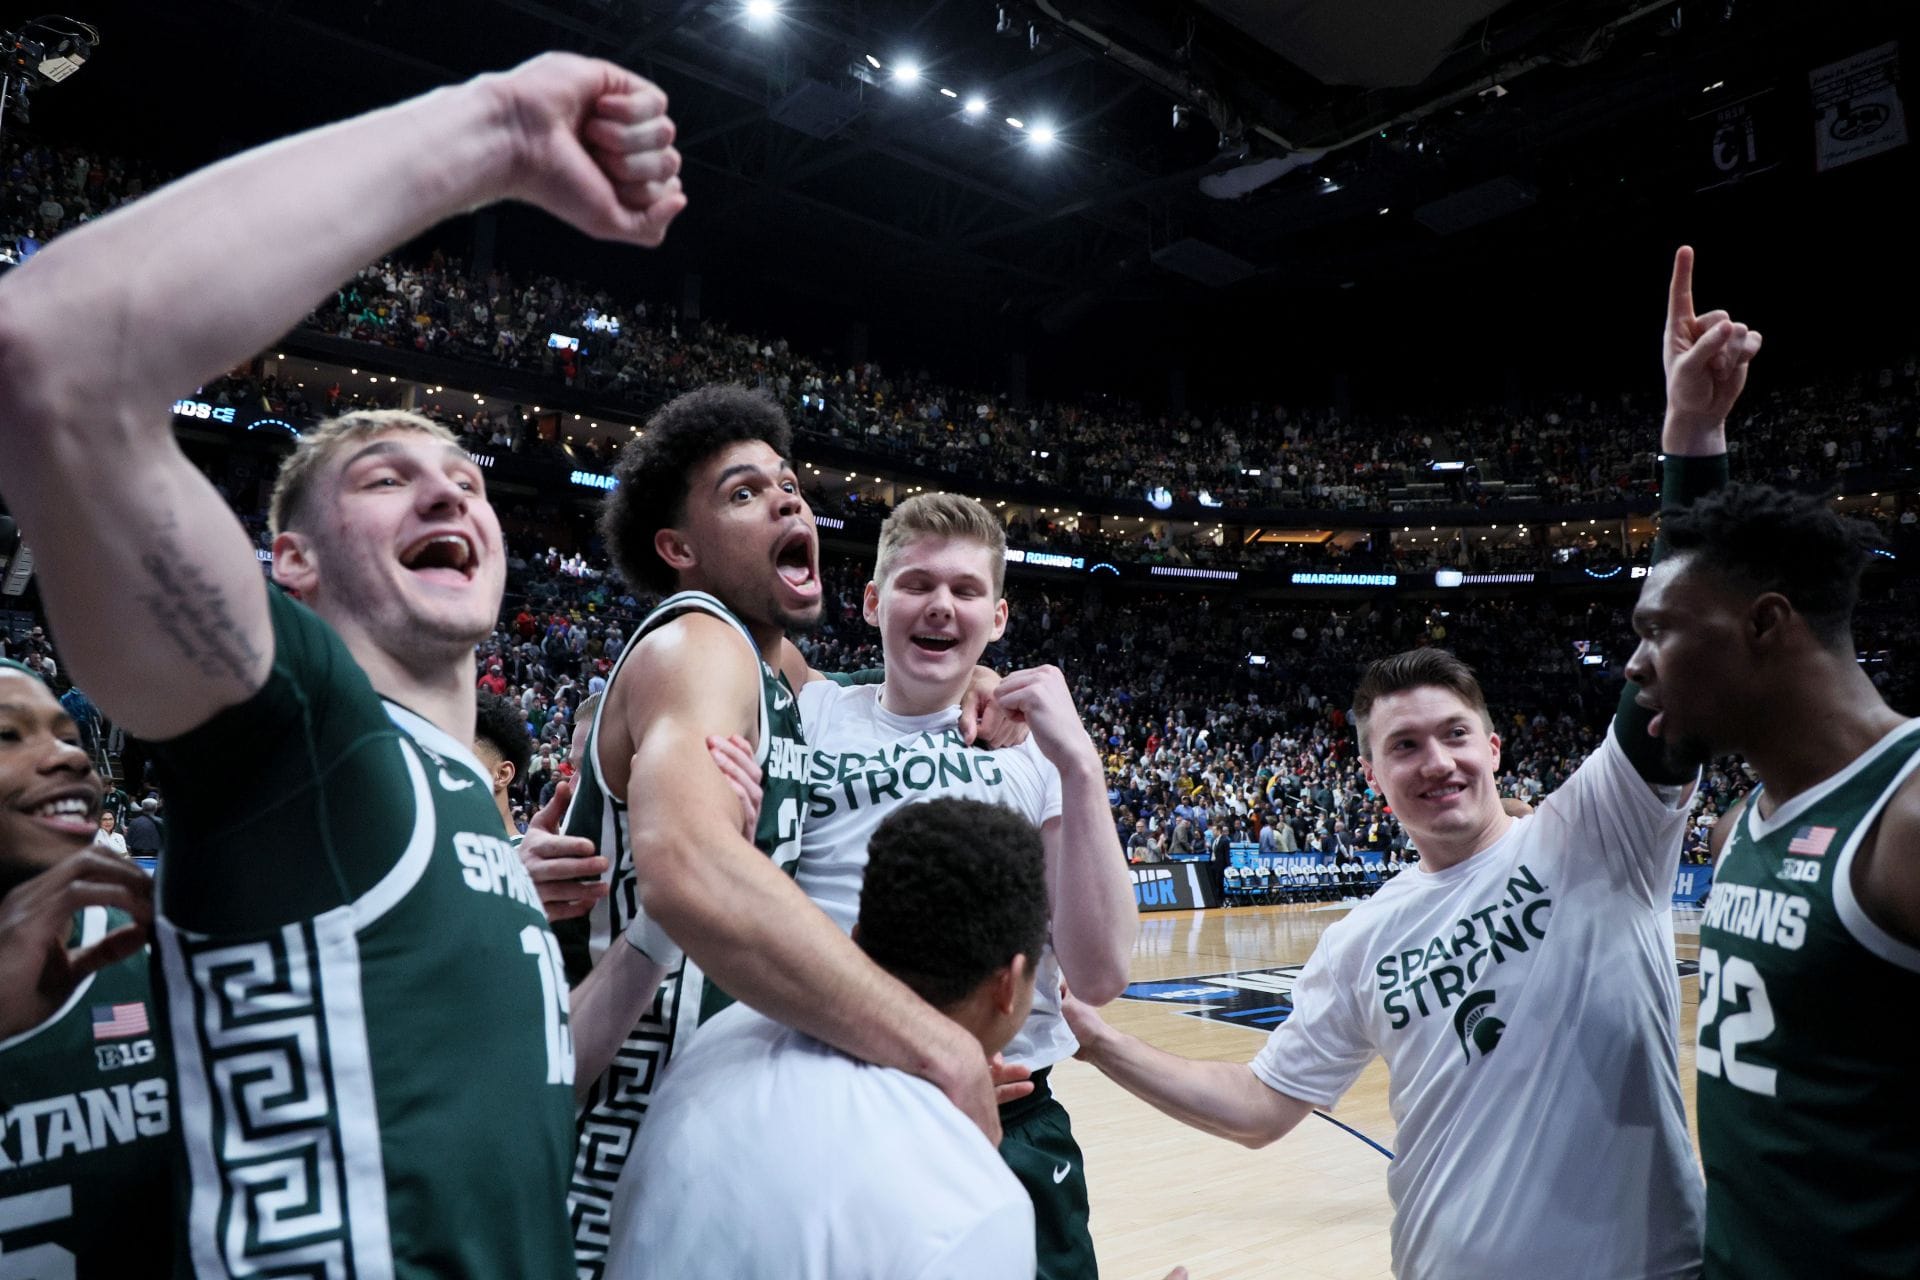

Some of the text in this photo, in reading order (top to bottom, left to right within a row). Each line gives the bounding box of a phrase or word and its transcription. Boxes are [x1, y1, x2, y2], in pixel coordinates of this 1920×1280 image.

[1292, 573, 1397, 586] #MARCHMADNESS
[808, 752, 1003, 819] STRONG
[1697, 948, 1777, 1098] 22
